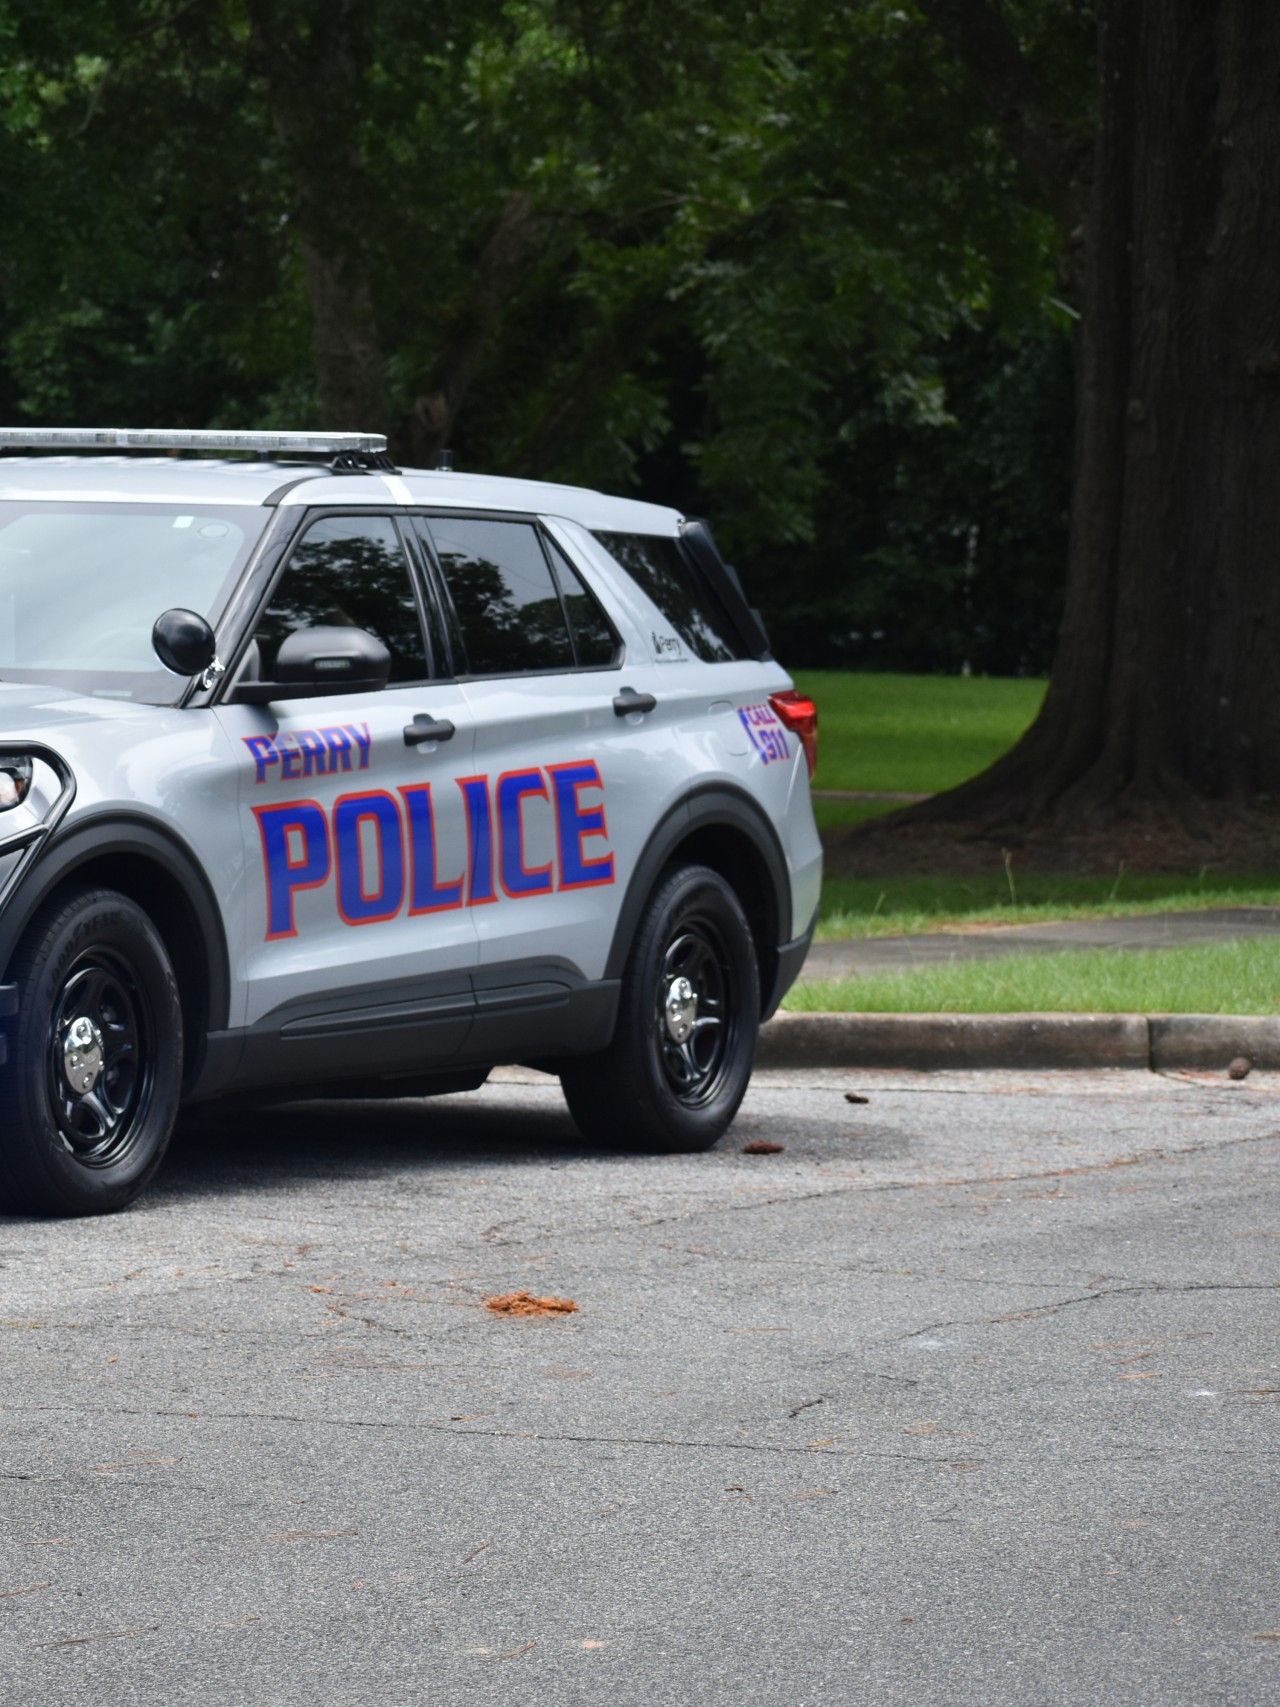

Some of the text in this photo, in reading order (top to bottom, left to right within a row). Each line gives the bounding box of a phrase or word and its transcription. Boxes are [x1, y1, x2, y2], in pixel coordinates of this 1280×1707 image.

[745, 704, 777, 726] CALL
[241, 722, 373, 784] PERRY
[758, 729, 791, 760] 911
[250, 758, 616, 943] POLICE
